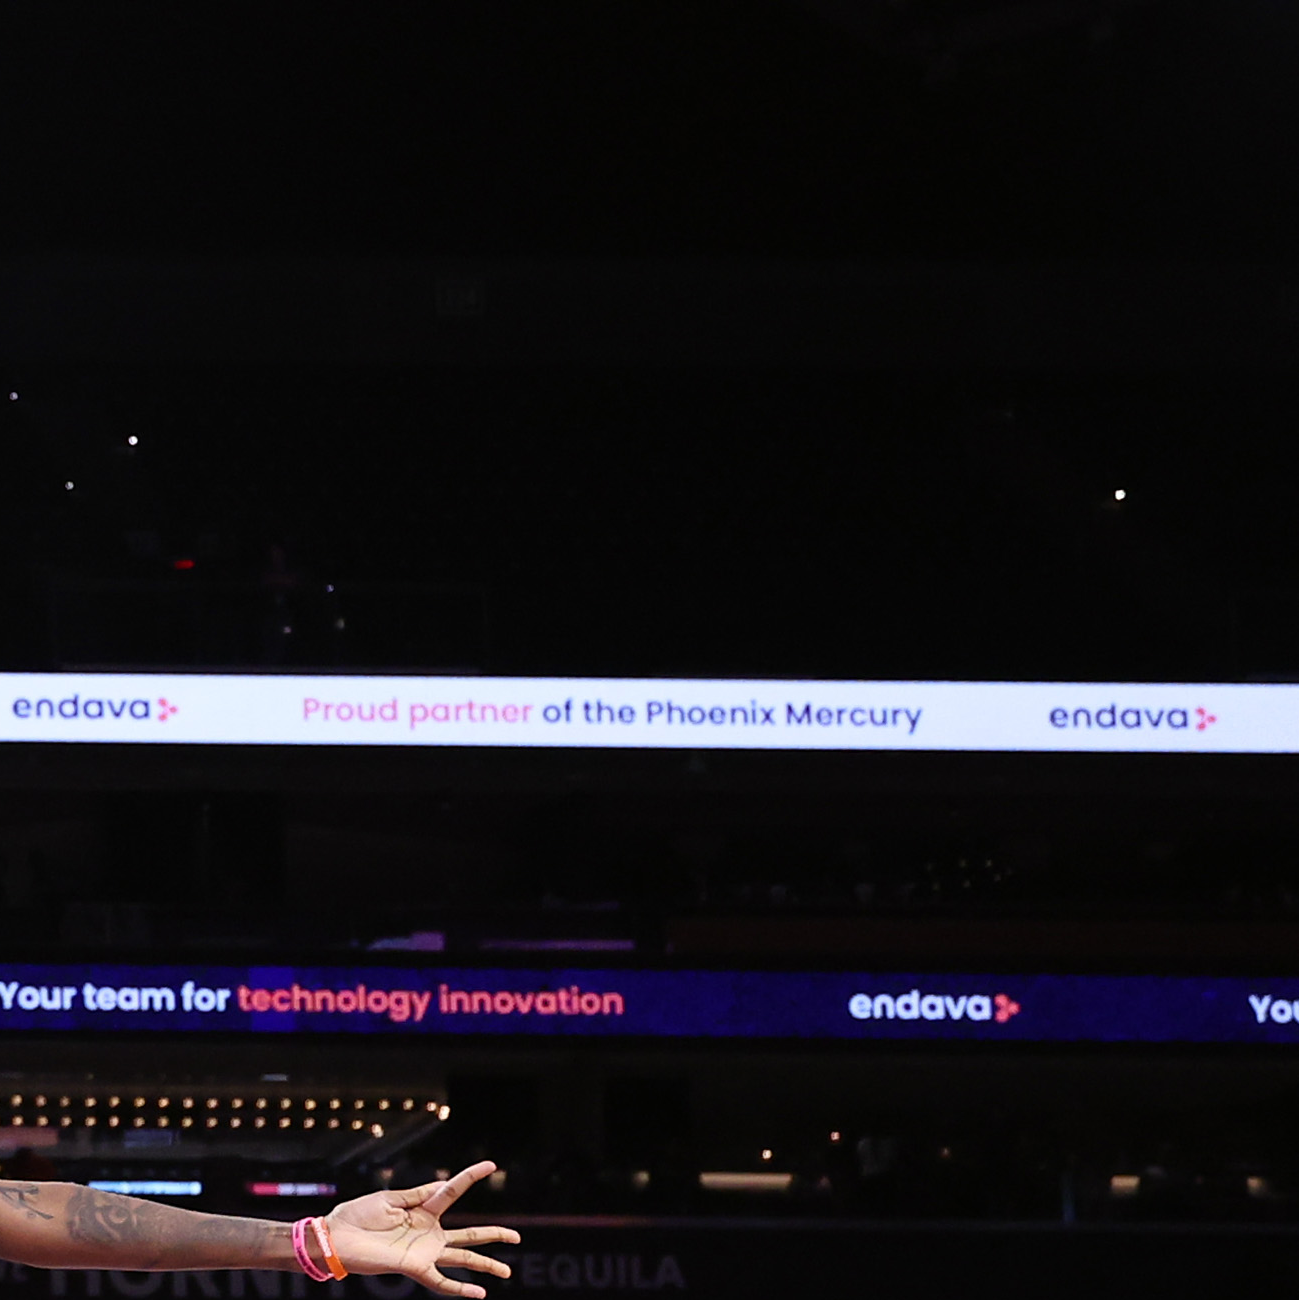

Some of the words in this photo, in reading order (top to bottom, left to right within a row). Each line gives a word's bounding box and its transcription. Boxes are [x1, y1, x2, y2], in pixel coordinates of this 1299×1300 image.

[12, 694, 150, 721] endava
[303, 696, 398, 723] Proud
[409, 702, 533, 732] partner
[542, 699, 573, 726] of
[583, 699, 636, 727] the
[647, 699, 776, 728] Phoenix
[786, 702, 923, 736] Mercury
[1049, 702, 1189, 731] endava
[83, 983, 174, 1013] team
[182, 980, 230, 1013] for
[238, 983, 428, 1022] technology
[438, 982, 624, 1016] innovation
[849, 989, 992, 1021] endava
